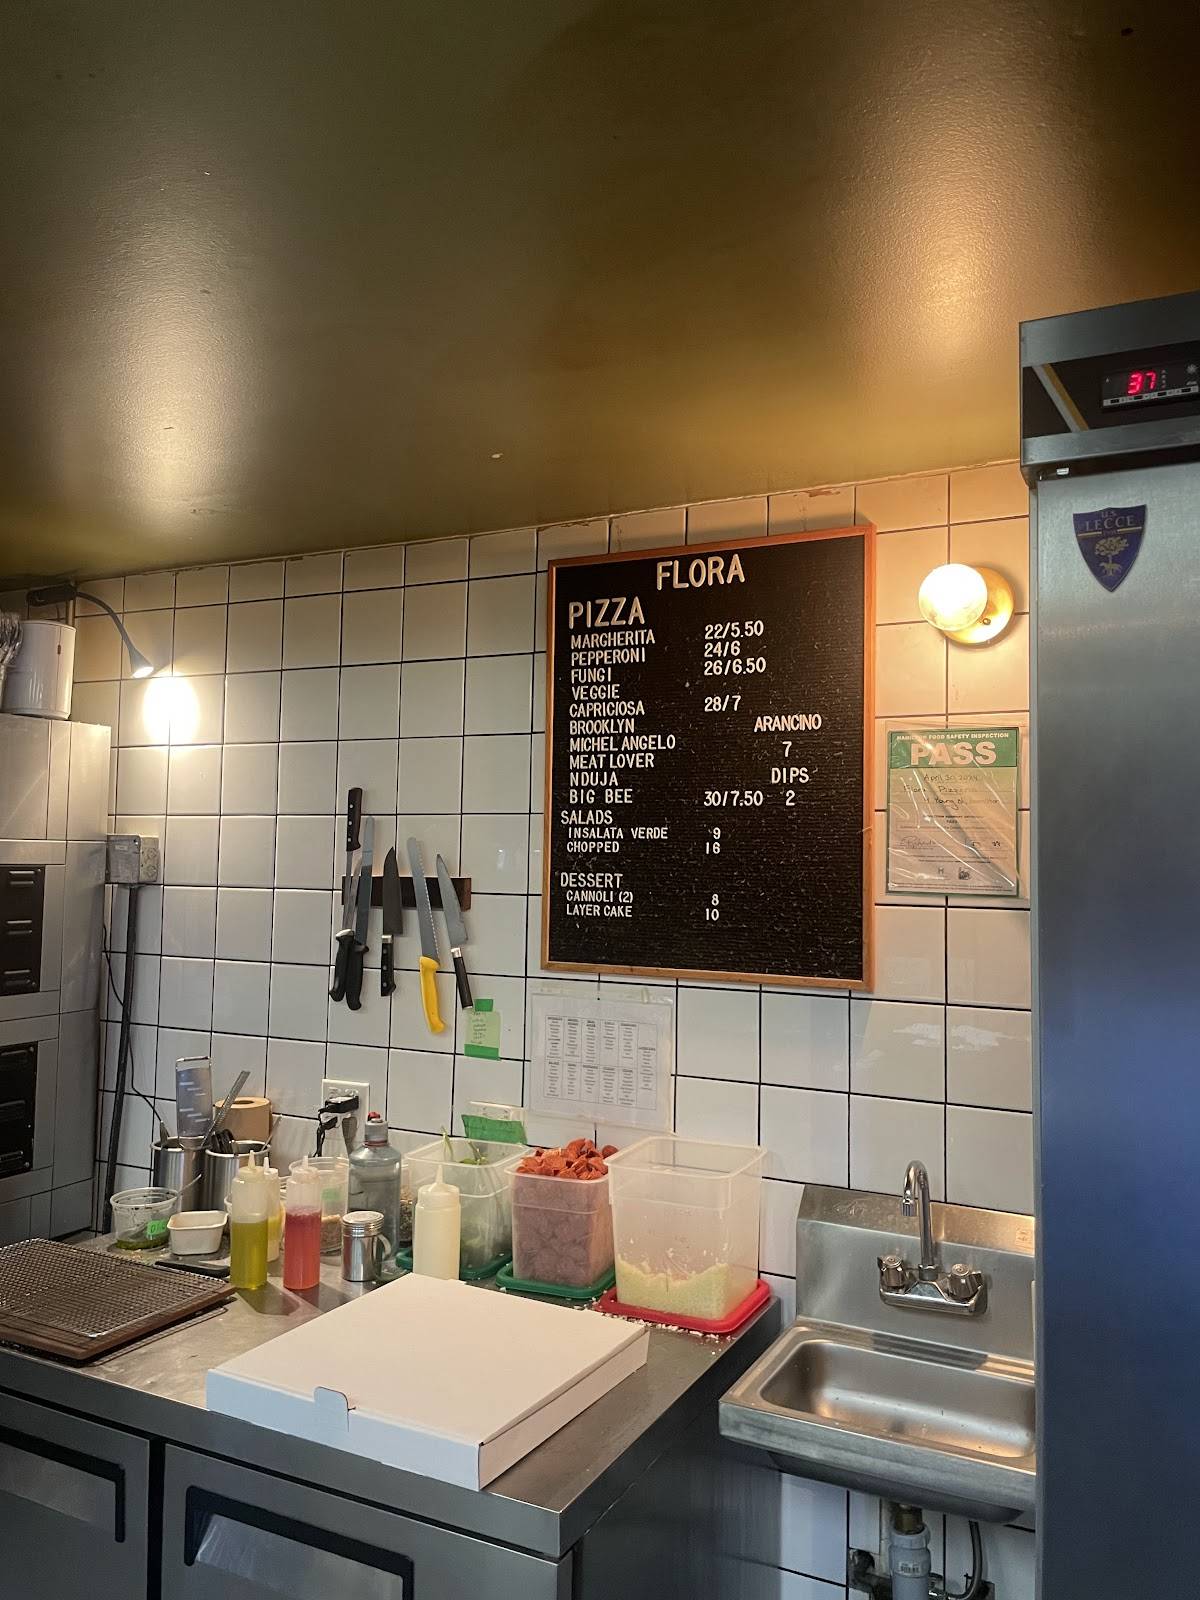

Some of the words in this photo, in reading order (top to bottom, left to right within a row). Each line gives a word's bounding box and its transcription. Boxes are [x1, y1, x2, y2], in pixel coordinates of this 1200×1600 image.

[1127, 371, 1157, 395] 37
[1085, 515, 1137, 531] LECCE
[657, 554, 745, 590] FLORA
[568, 596, 645, 629] PIZZA
[571, 629, 655, 650] MARGHERITA
[704, 620, 764, 640] 22/5.50
[571, 648, 646, 666] PEPPERONI
[704, 641, 741, 658] 24/6
[571, 667, 612, 684] FUNGI
[703, 657, 766, 676] 26/6.50
[571, 684, 620, 700] VEGGIE
[569, 701, 645, 717] CAPRICIOSA
[704, 695, 741, 712] 28/7
[569, 718, 635, 735] BROOKLYN
[754, 714, 822, 732] ARANCINO
[569, 736, 618, 752] MICHEL
[621, 735, 676, 751] ANGELO
[782, 741, 792, 757] 7
[569, 753, 605, 769] MEAT
[609, 753, 654, 769] LOVER
[910, 741, 997, 766] PASS
[569, 771, 618, 786] NDUJA
[771, 767, 810, 784] DIPS
[569, 789, 596, 804] BIG
[605, 789, 633, 804] BEE
[703, 790, 763, 807] 30/7.50
[785, 790, 796, 806] 2
[560, 810, 613, 825] SALADS
[568, 827, 624, 839] INSALATA
[631, 827, 668, 840] VERDE
[712, 827, 721, 840] 9
[566, 841, 620, 853] CHOPPED
[705, 841, 721, 855] 16
[560, 872, 623, 888] DESSERT
[566, 890, 613, 903] CANNOLI
[618, 891, 634, 904] (2)
[711, 893, 719, 906] 8
[566, 904, 600, 917] LAYER
[603, 906, 633, 918] CAKE
[705, 908, 720, 921] 10
